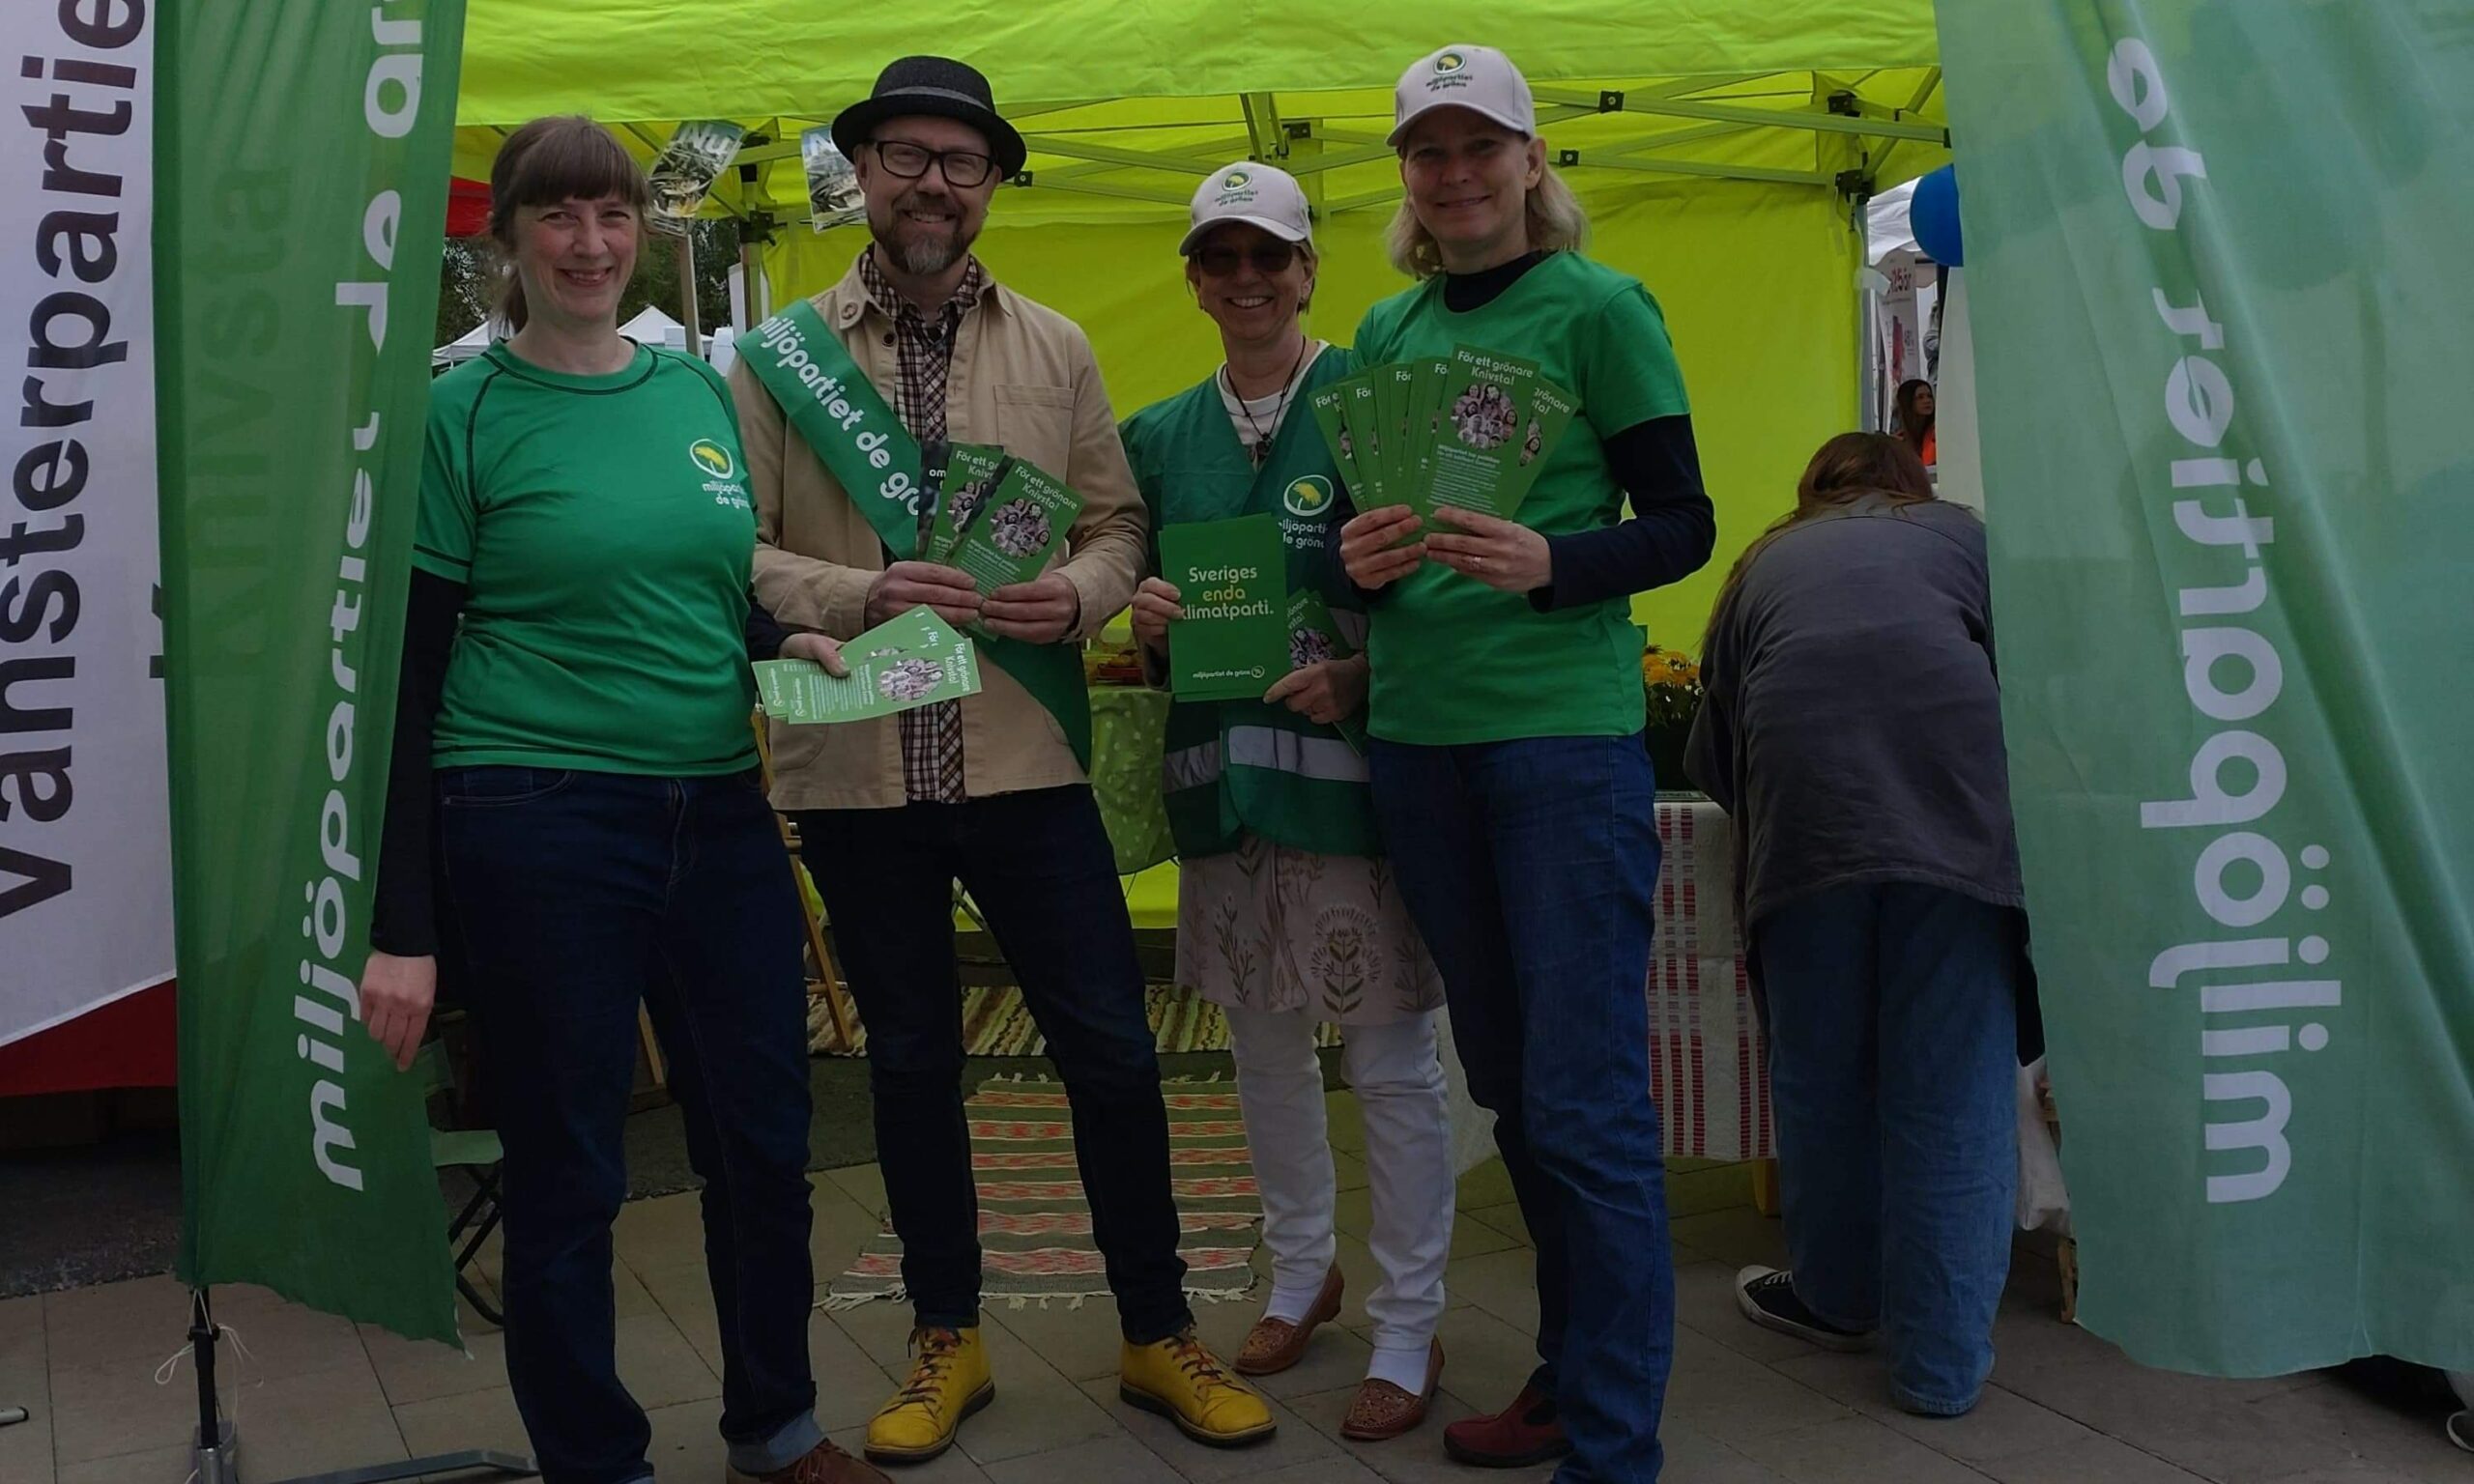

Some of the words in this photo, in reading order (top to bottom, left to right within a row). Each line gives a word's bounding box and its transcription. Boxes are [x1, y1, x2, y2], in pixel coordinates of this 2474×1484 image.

[1434, 362, 1449, 375] Fö
[1457, 350, 1474, 363] För
[1475, 355, 1491, 367] ett
[1491, 361, 1534, 379] grönare
[1471, 366, 1515, 385] Knivsta!
[855, 431, 890, 470] de
[955, 449, 971, 463] För
[1015, 466, 1030, 480] För
[1029, 474, 1045, 489] ett
[1043, 484, 1078, 511] grönare
[1188, 565, 1257, 584] Sveriges
[1202, 585, 1247, 602] enda
